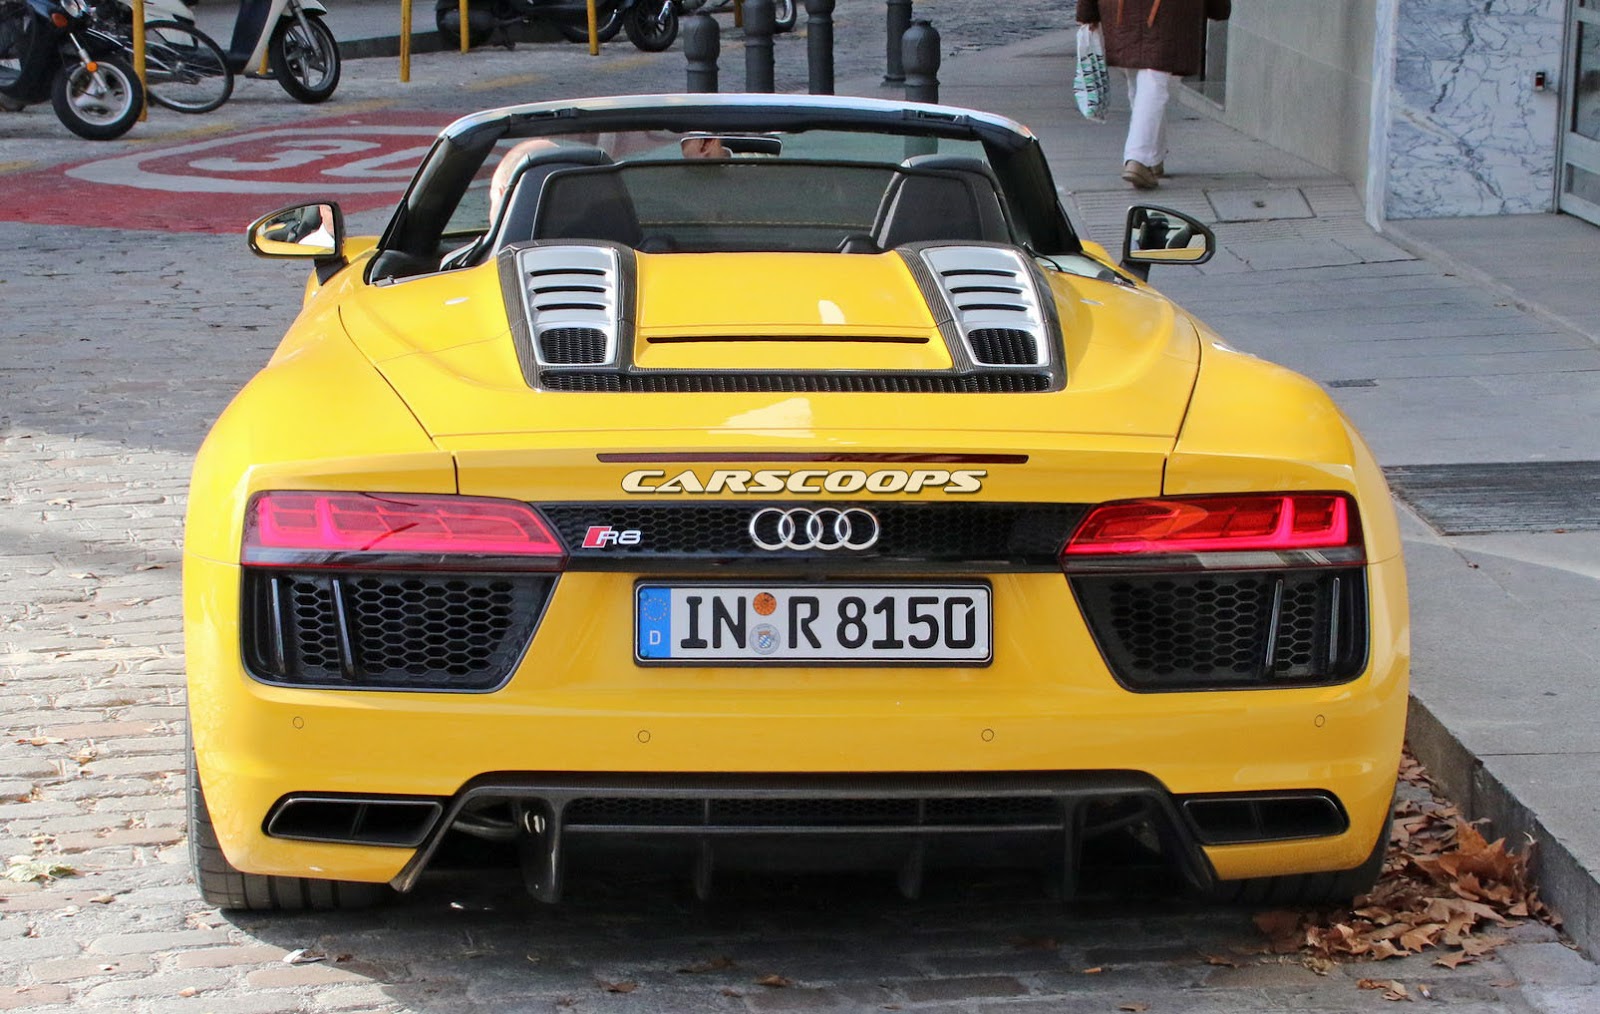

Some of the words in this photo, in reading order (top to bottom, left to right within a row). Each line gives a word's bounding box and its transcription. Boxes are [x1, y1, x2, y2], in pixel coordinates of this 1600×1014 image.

[595, 528, 642, 546] R8
[680, 596, 747, 649] IN
[788, 596, 822, 649] R
[836, 596, 976, 649] 8150
[649, 629, 661, 646] D
